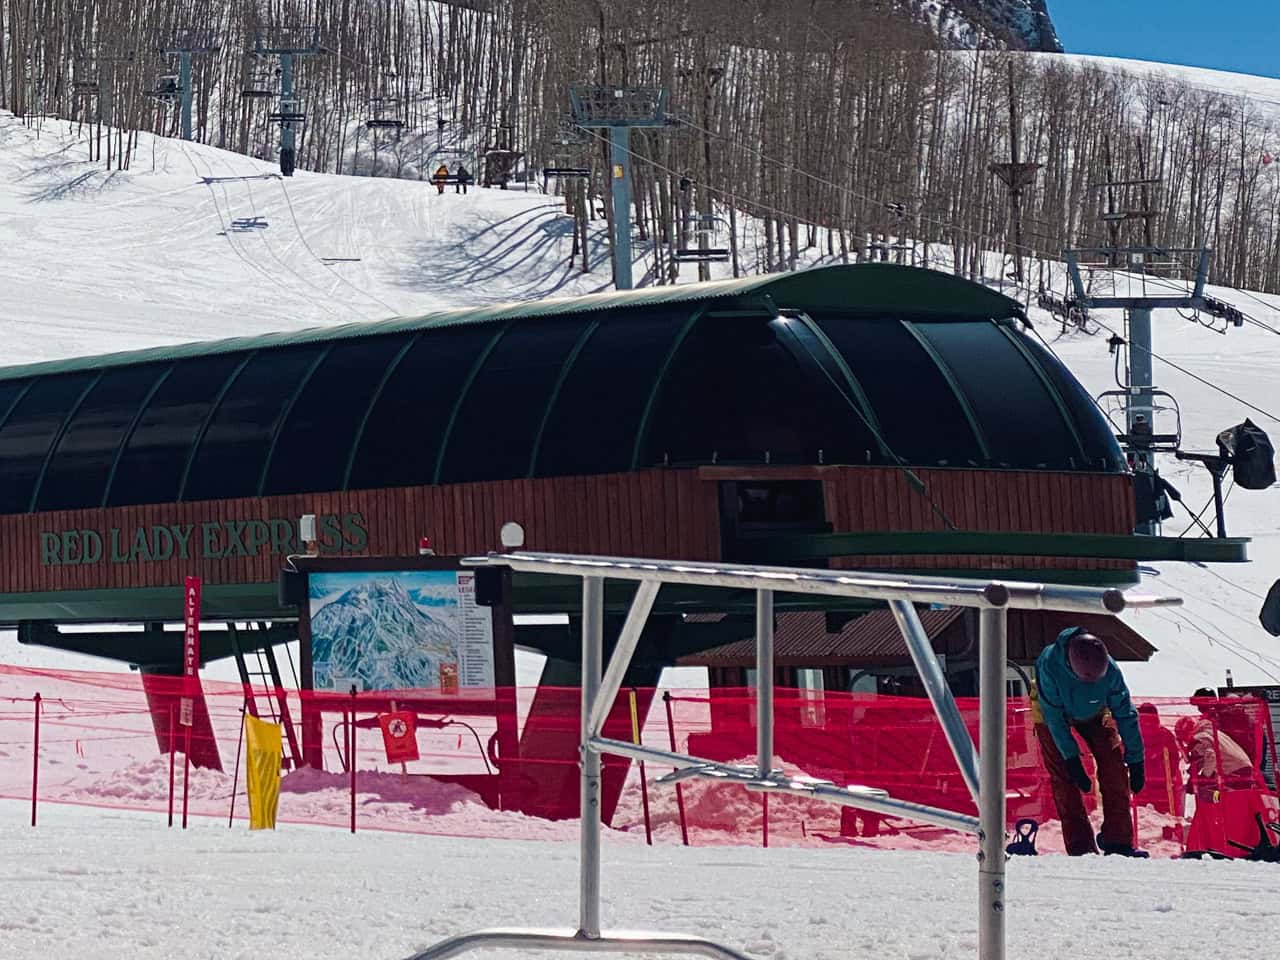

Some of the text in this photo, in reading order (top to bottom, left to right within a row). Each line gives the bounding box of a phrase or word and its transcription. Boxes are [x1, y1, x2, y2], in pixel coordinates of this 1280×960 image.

[40, 528, 103, 566] RED
[110, 523, 195, 563] LADY
[186, 587, 196, 676] ALTERNATE
